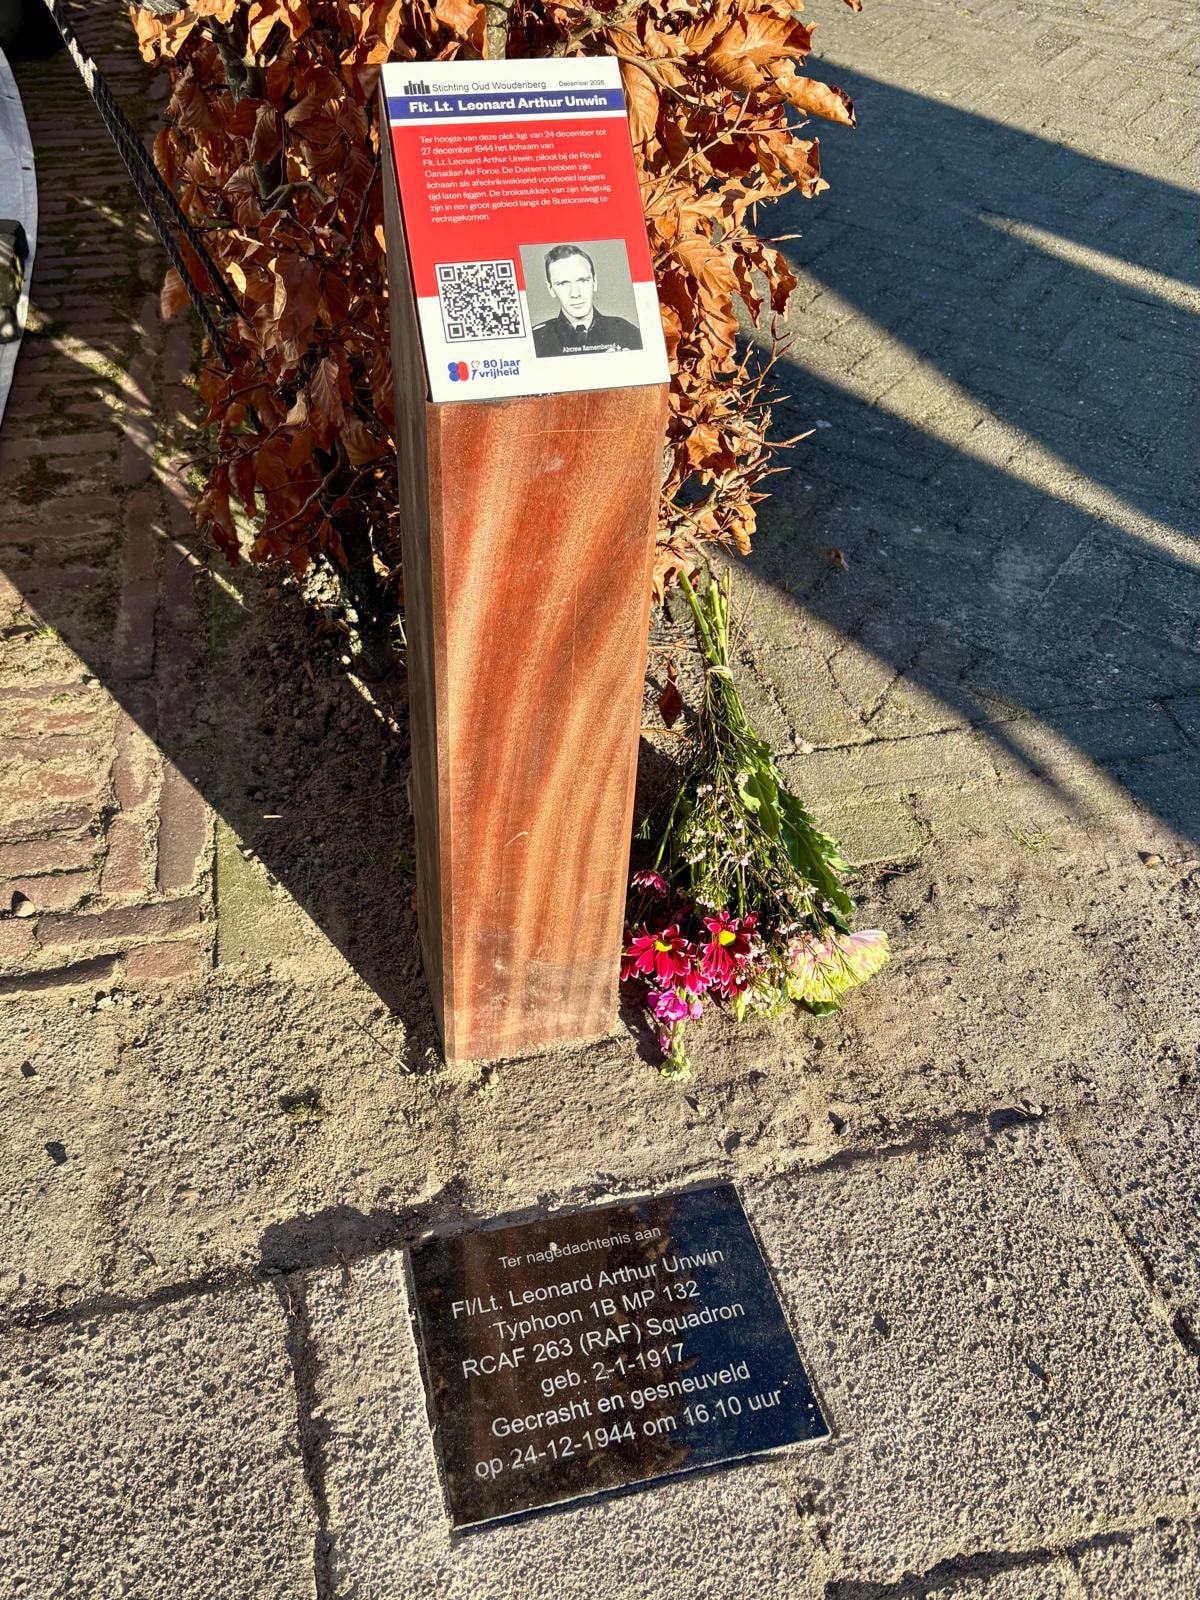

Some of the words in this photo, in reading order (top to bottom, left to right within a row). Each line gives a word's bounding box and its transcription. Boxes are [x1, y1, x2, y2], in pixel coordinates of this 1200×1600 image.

[432, 83, 469, 92] Stichting
[472, 82, 490, 90] Oud
[492, 81, 546, 90] Woudenberg
[409, 102, 432, 112] Flt.
[434, 101, 454, 112] Lt.
[458, 98, 516, 110] Leonard
[518, 97, 562, 108] Arthur
[565, 95, 608, 106] Unwin
[434, 136, 462, 144] hoogte
[499, 132, 514, 141] plek
[516, 132, 528, 140] ligt
[432, 146, 472, 154] december
[474, 144, 494, 152] 1944
[509, 143, 539, 151] lichaam
[448, 157, 481, 165] Leonard
[536, 154, 557, 162] piloot
[558, 152, 568, 160] bij
[580, 151, 601, 159] Royal
[424, 170, 462, 178] Canadian
[514, 165, 547, 173] Duitsers
[548, 164, 576, 172] hebben
[578, 163, 590, 172] zijn
[426, 181, 458, 189] lichaam
[538, 174, 576, 183] voorbeeld
[578, 174, 606, 182] langere
[428, 194, 440, 202] tijd
[502, 188, 550, 196] brokstukken
[566, 186, 578, 194] zijn
[580, 184, 611, 193] vliegtuig
[430, 204, 444, 213] zijn
[470, 202, 490, 211] groot
[492, 200, 518, 210] gebied
[520, 199, 540, 208] langs
[552, 196, 599, 205] Stationsweg
[483, 360, 498, 368] 80
[500, 358, 520, 370] jaar
[479, 367, 520, 379] vrijheid
[498, 1256, 522, 1268] Ter
[526, 1233, 630, 1262] nagedachtenis
[635, 1227, 662, 1241] aan
[452, 1294, 503, 1319] Fl/Lt.
[509, 1274, 592, 1306] Leonard
[598, 1264, 657, 1288] Arthur
[662, 1249, 724, 1273] Unwin
[492, 1309, 583, 1341] Typhoon
[590, 1298, 616, 1318] 1B
[622, 1290, 655, 1312] MP
[662, 1280, 700, 1302] 132
[462, 1348, 526, 1379] RCAF
[532, 1338, 573, 1363] 263
[580, 1322, 642, 1356] (RAF)
[646, 1303, 745, 1336] Squadron
[541, 1369, 588, 1397] geb.
[592, 1343, 684, 1380] 2-1-1917
[492, 1398, 592, 1437] Gecrasht
[598, 1394, 624, 1412] en
[630, 1361, 750, 1410] gesneuveld
[476, 1458, 502, 1479] op
[510, 1421, 636, 1469] 24-12-1944
[642, 1416, 677, 1436] om
[683, 1396, 742, 1426] 16.10
[748, 1390, 782, 1410] uur
